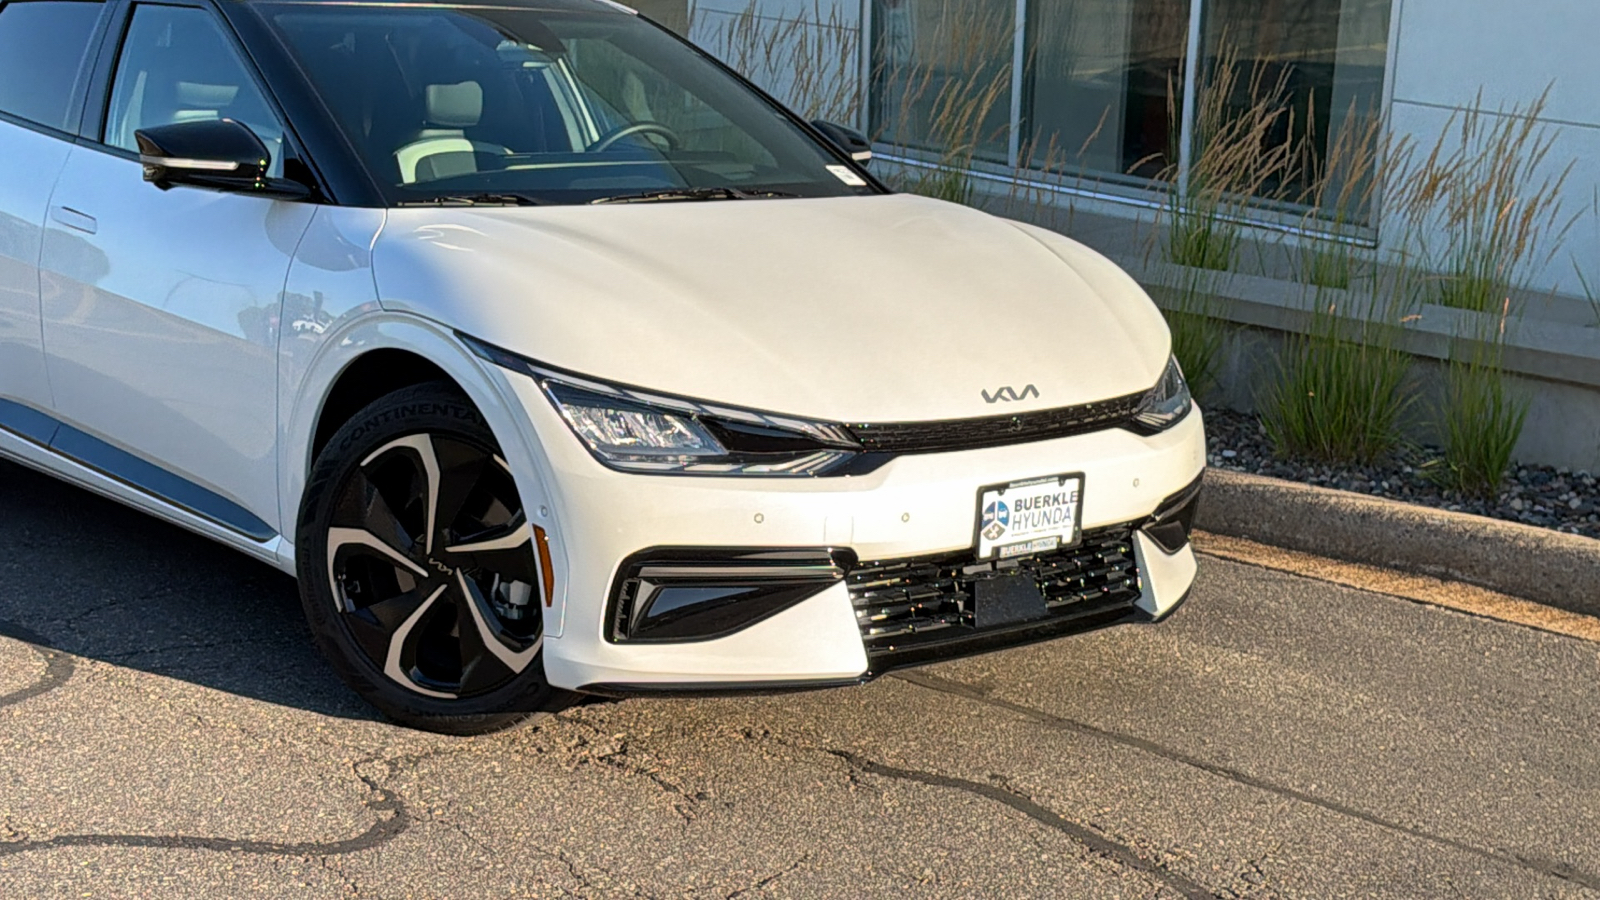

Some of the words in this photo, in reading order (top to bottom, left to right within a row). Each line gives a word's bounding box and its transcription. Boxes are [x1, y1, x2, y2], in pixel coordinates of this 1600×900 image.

[981, 384, 1040, 404] KIA
[340, 402, 486, 451] CONTINENTA
[1014, 490, 1079, 512] BUERKLE
[1012, 506, 1073, 531] HYUNDA
